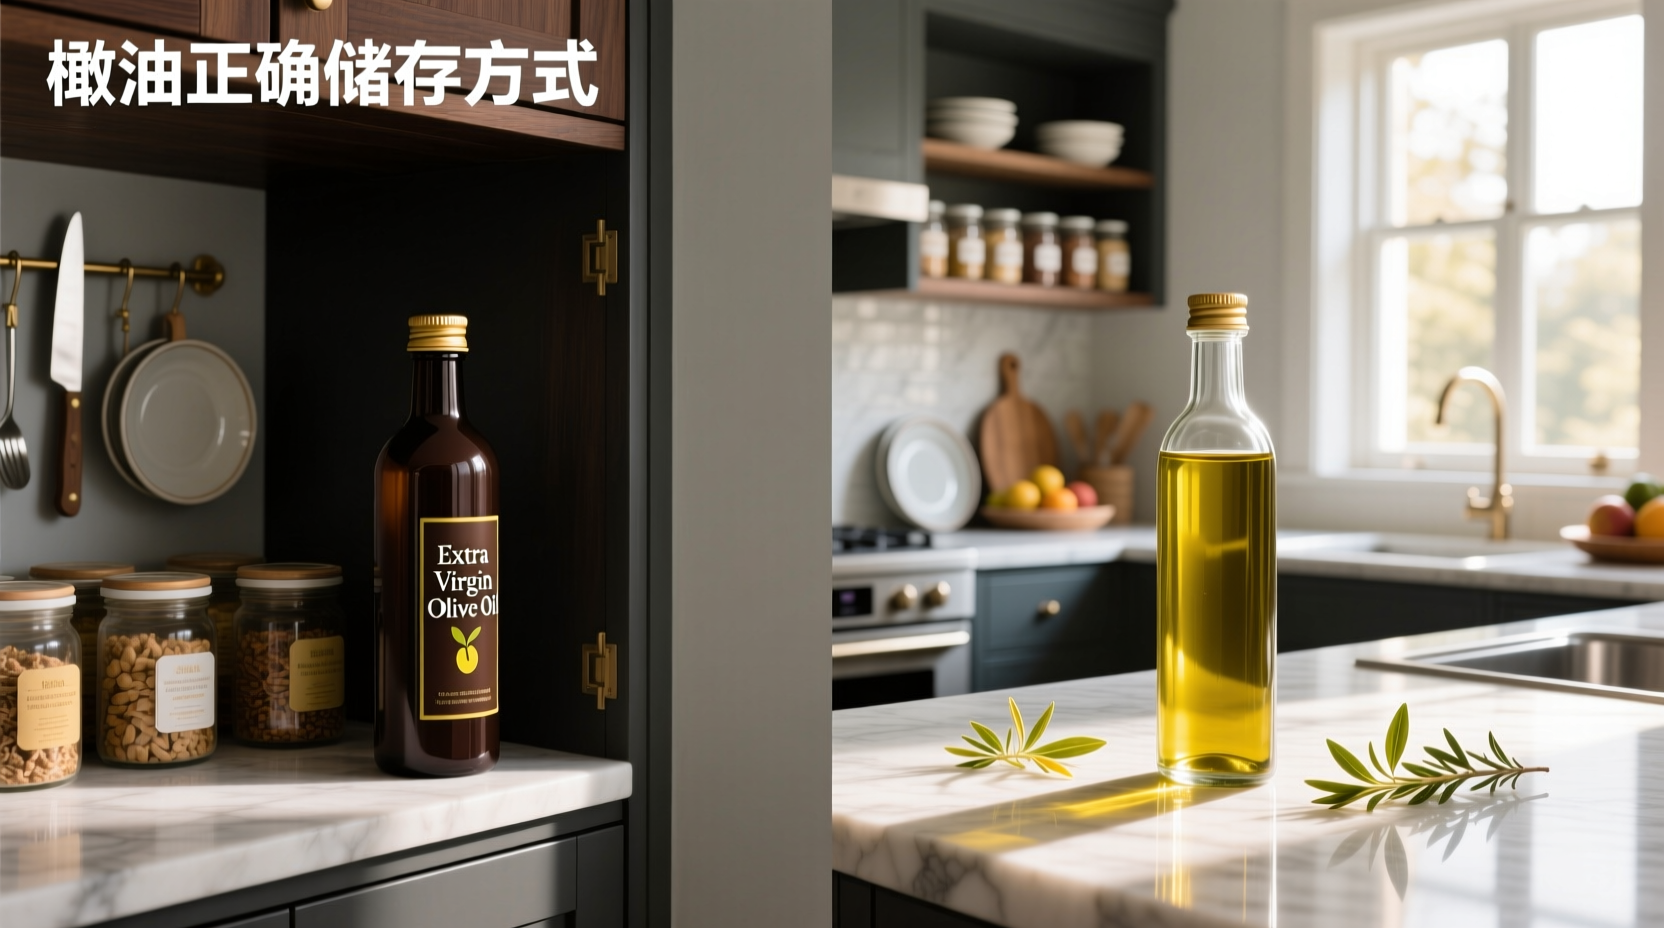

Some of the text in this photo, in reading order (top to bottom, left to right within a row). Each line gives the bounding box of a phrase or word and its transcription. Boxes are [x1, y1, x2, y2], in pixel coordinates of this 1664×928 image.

[437, 544, 489, 565] Extra
[433, 570, 493, 597] Virgin
[427, 597, 478, 619] Olive
